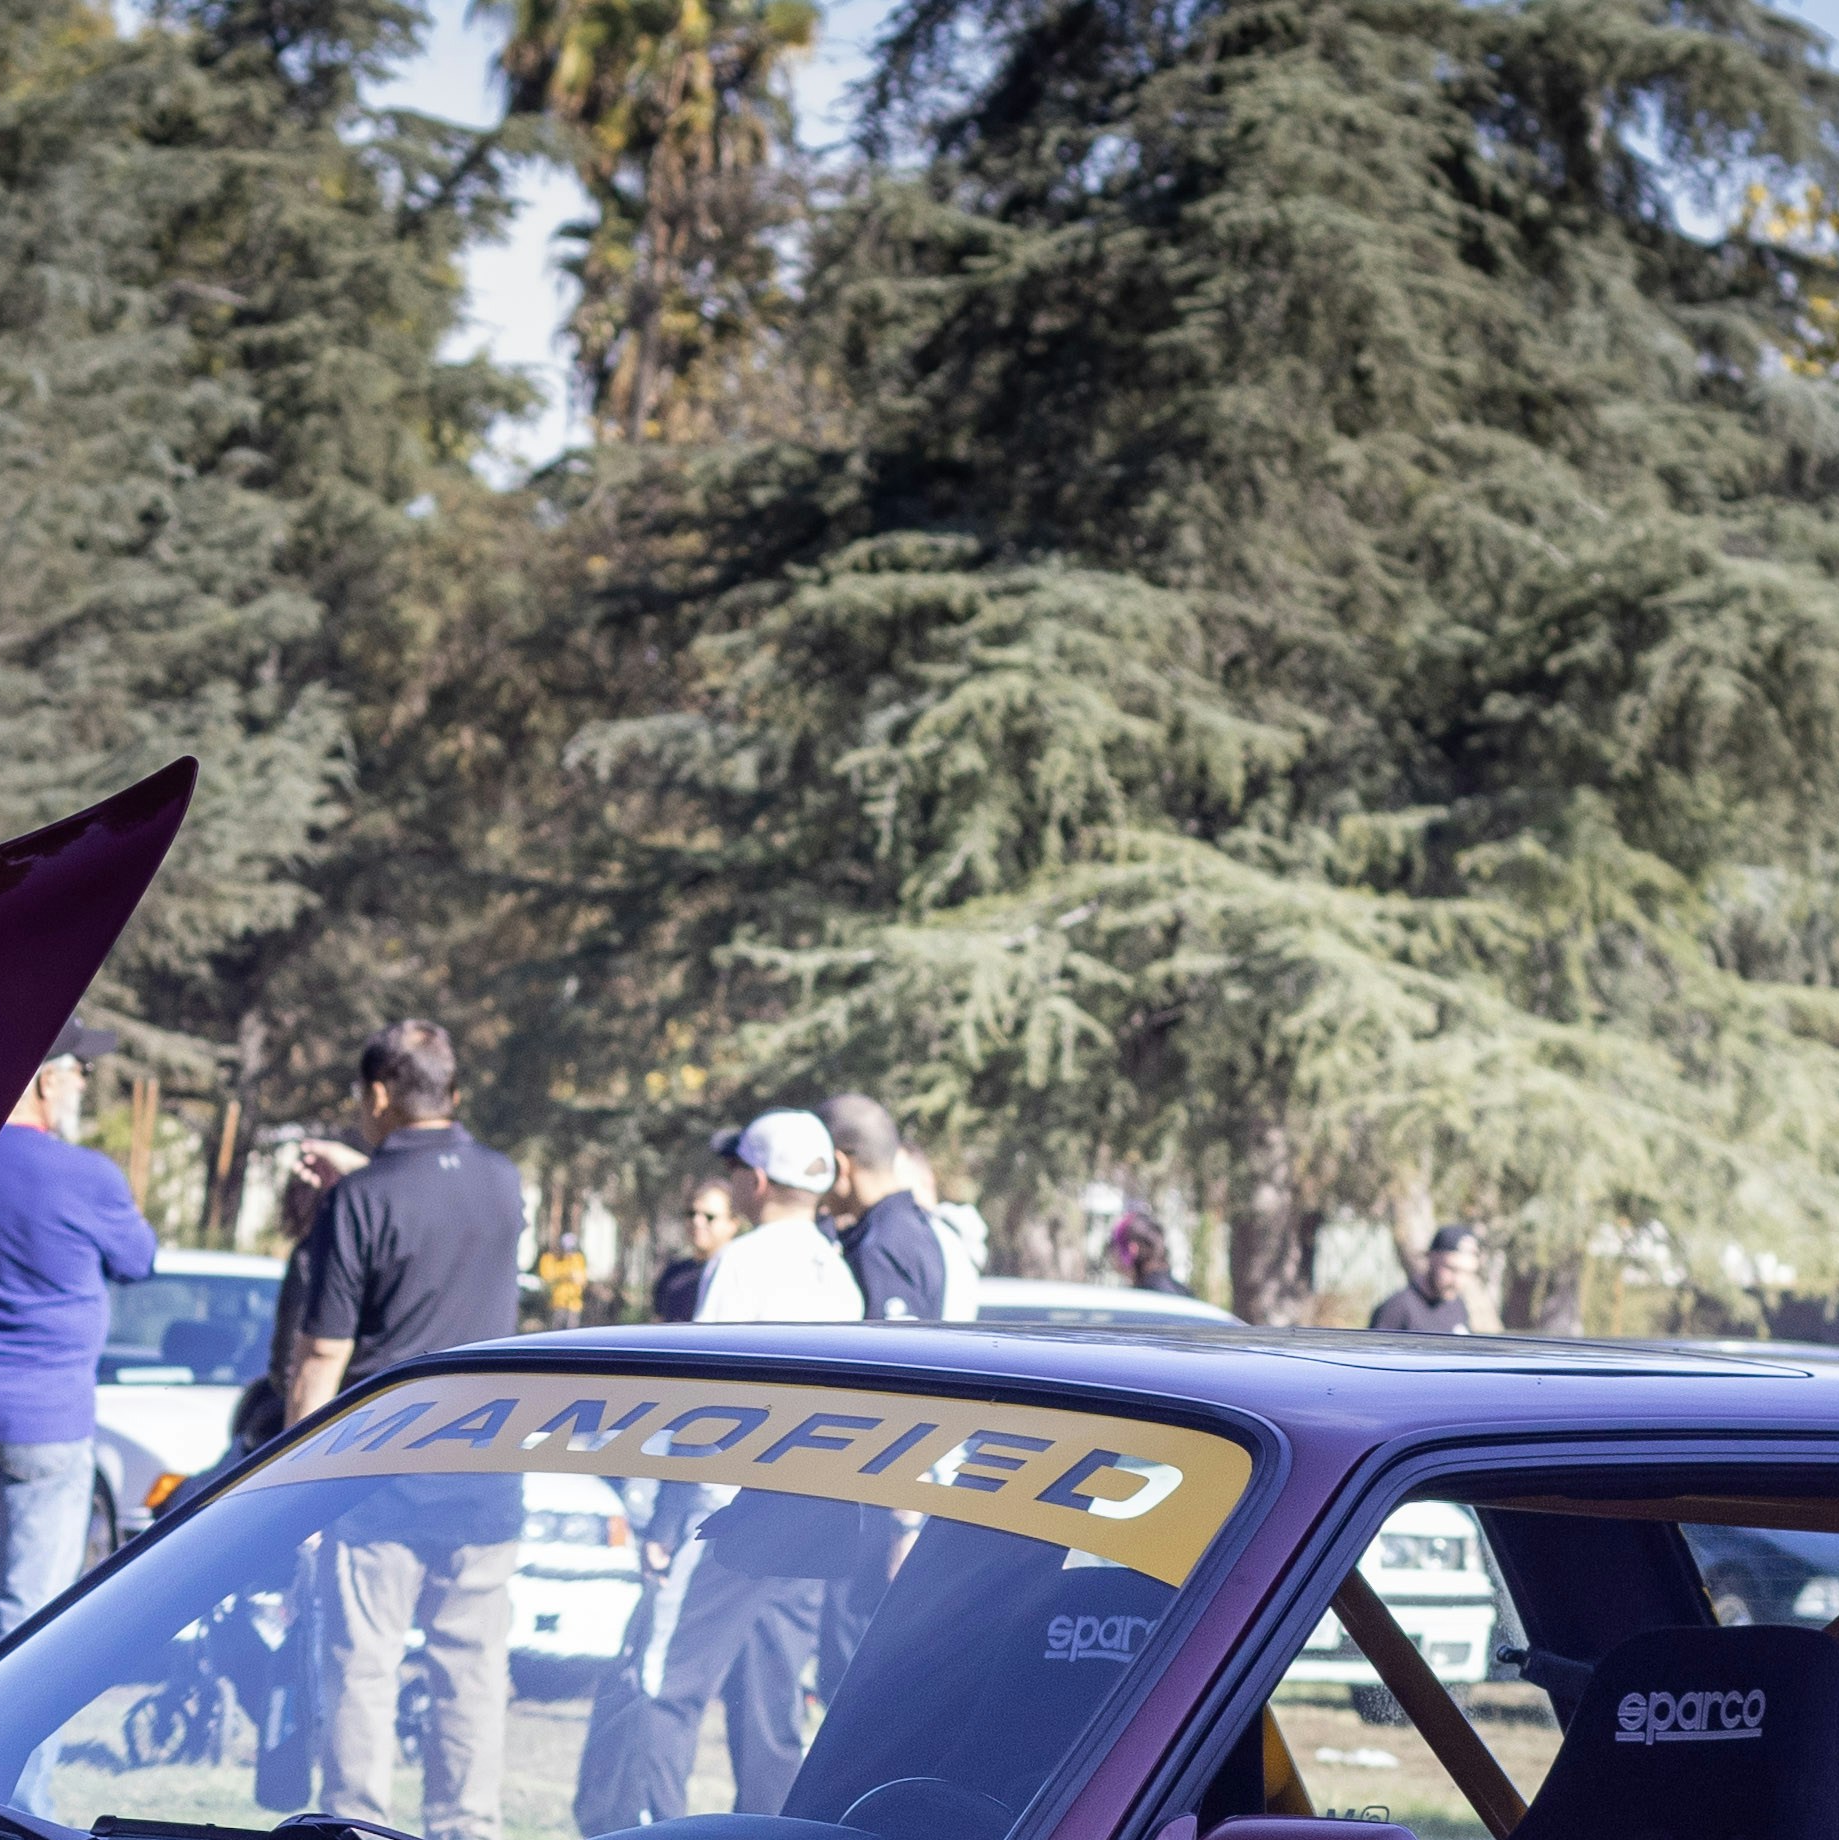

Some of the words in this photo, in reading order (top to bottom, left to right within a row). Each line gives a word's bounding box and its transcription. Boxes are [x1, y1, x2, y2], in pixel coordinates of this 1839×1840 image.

[290, 1397, 1184, 1521] MANOFIED
[1045, 1614, 1160, 1662] spar
[1616, 1688, 1767, 1746] sparco
